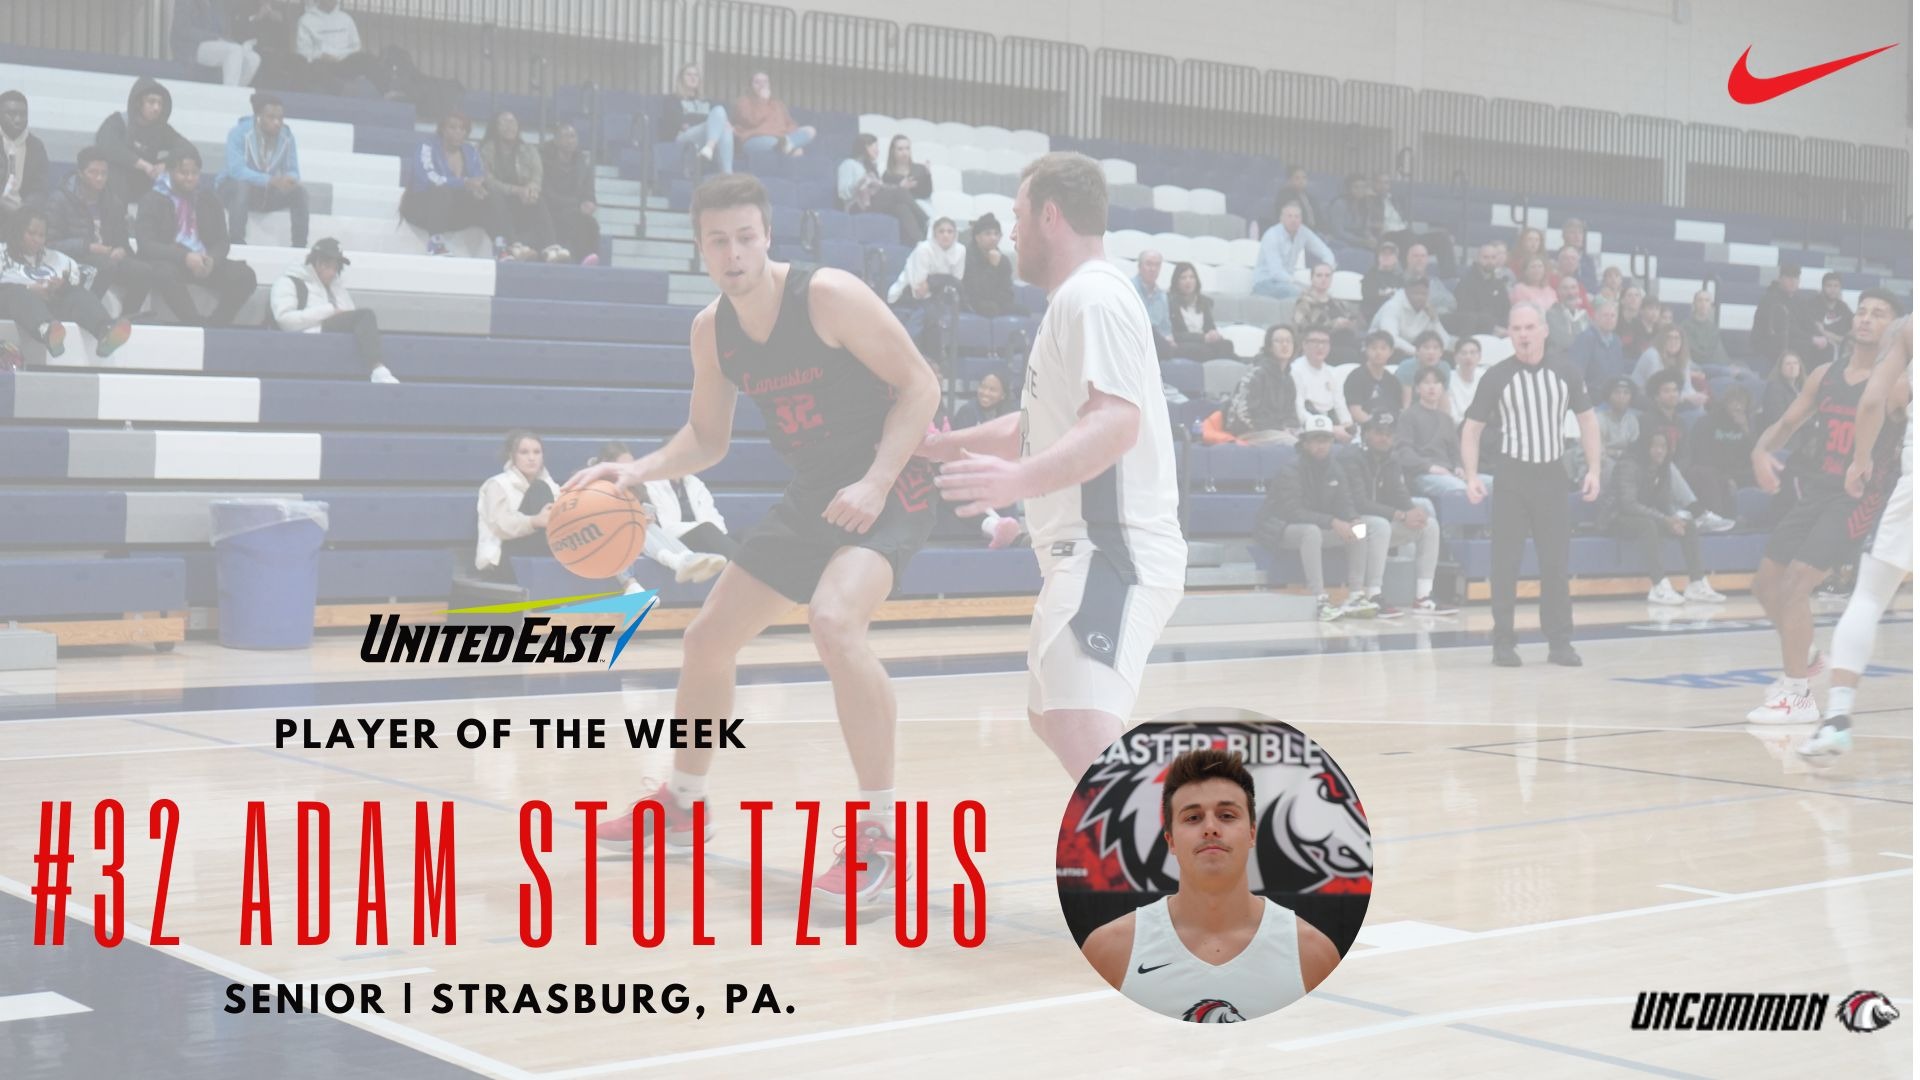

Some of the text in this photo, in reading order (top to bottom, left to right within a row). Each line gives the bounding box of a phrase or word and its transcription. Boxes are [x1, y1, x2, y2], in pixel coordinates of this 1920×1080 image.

[773, 393, 824, 434] 32
[1825, 419, 1857, 455] 30
[1226, 732, 1323, 765] BIBLE
